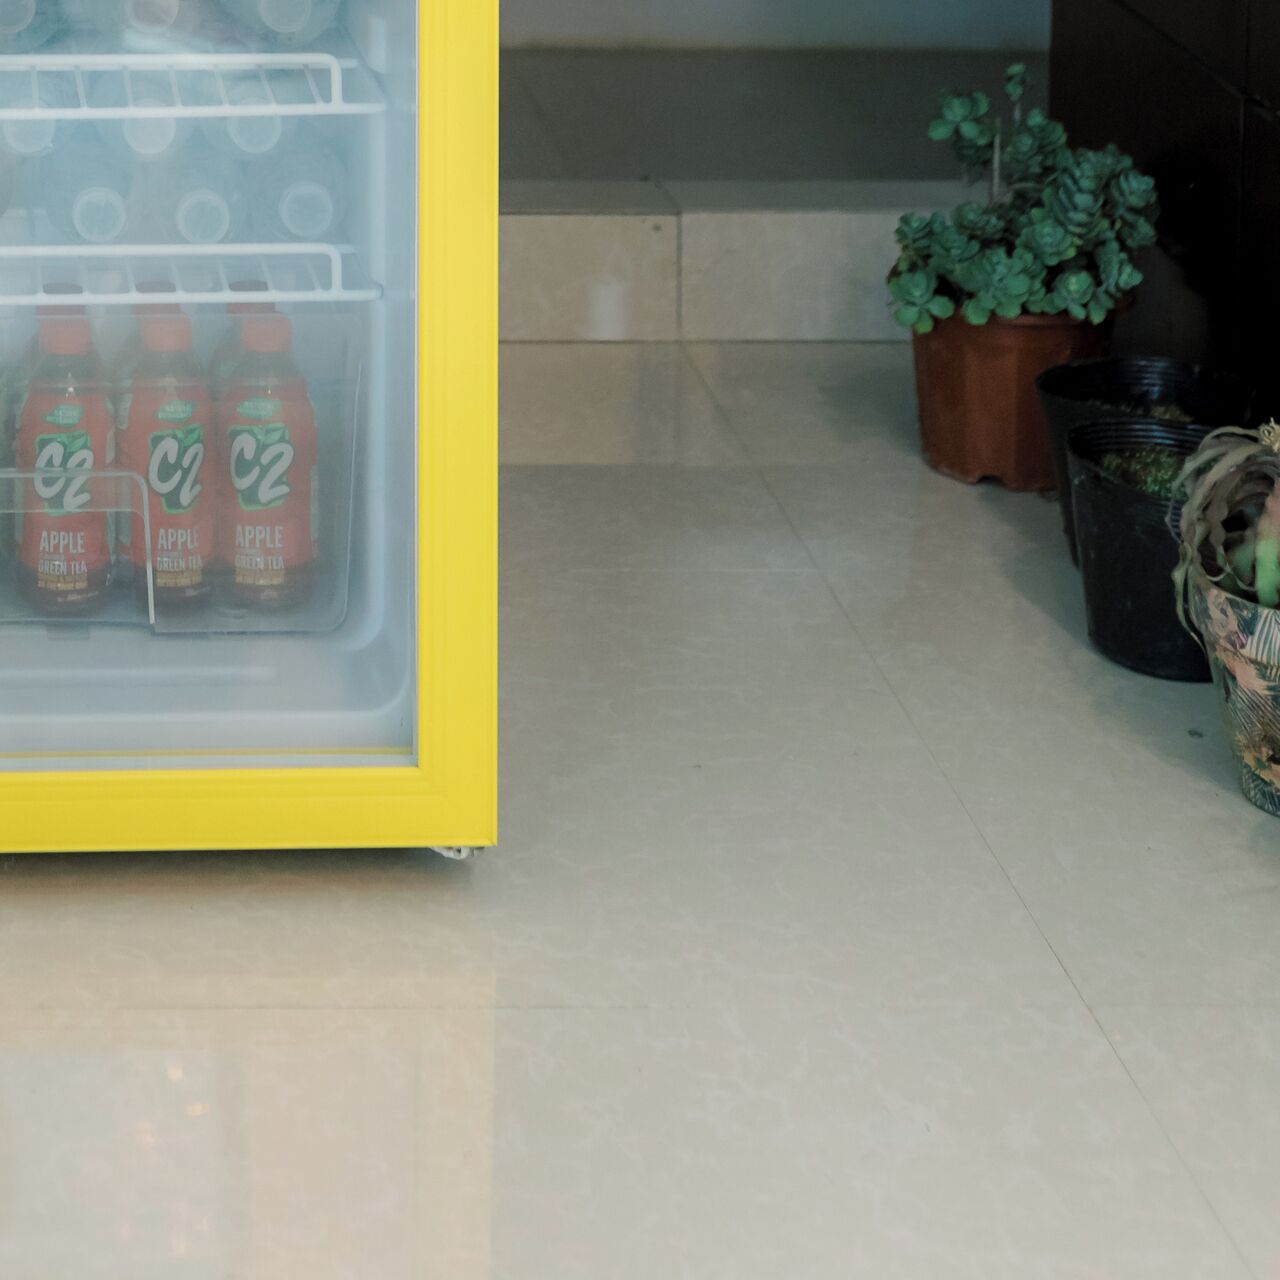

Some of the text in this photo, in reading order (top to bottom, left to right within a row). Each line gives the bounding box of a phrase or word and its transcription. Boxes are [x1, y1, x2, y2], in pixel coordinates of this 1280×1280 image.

[33, 440, 95, 512] C2
[148, 437, 205, 508] C2
[229, 432, 295, 504] C2
[39, 529, 86, 554] APPLE
[235, 525, 284, 549] APPLE
[71, 560, 88, 575] TEA
